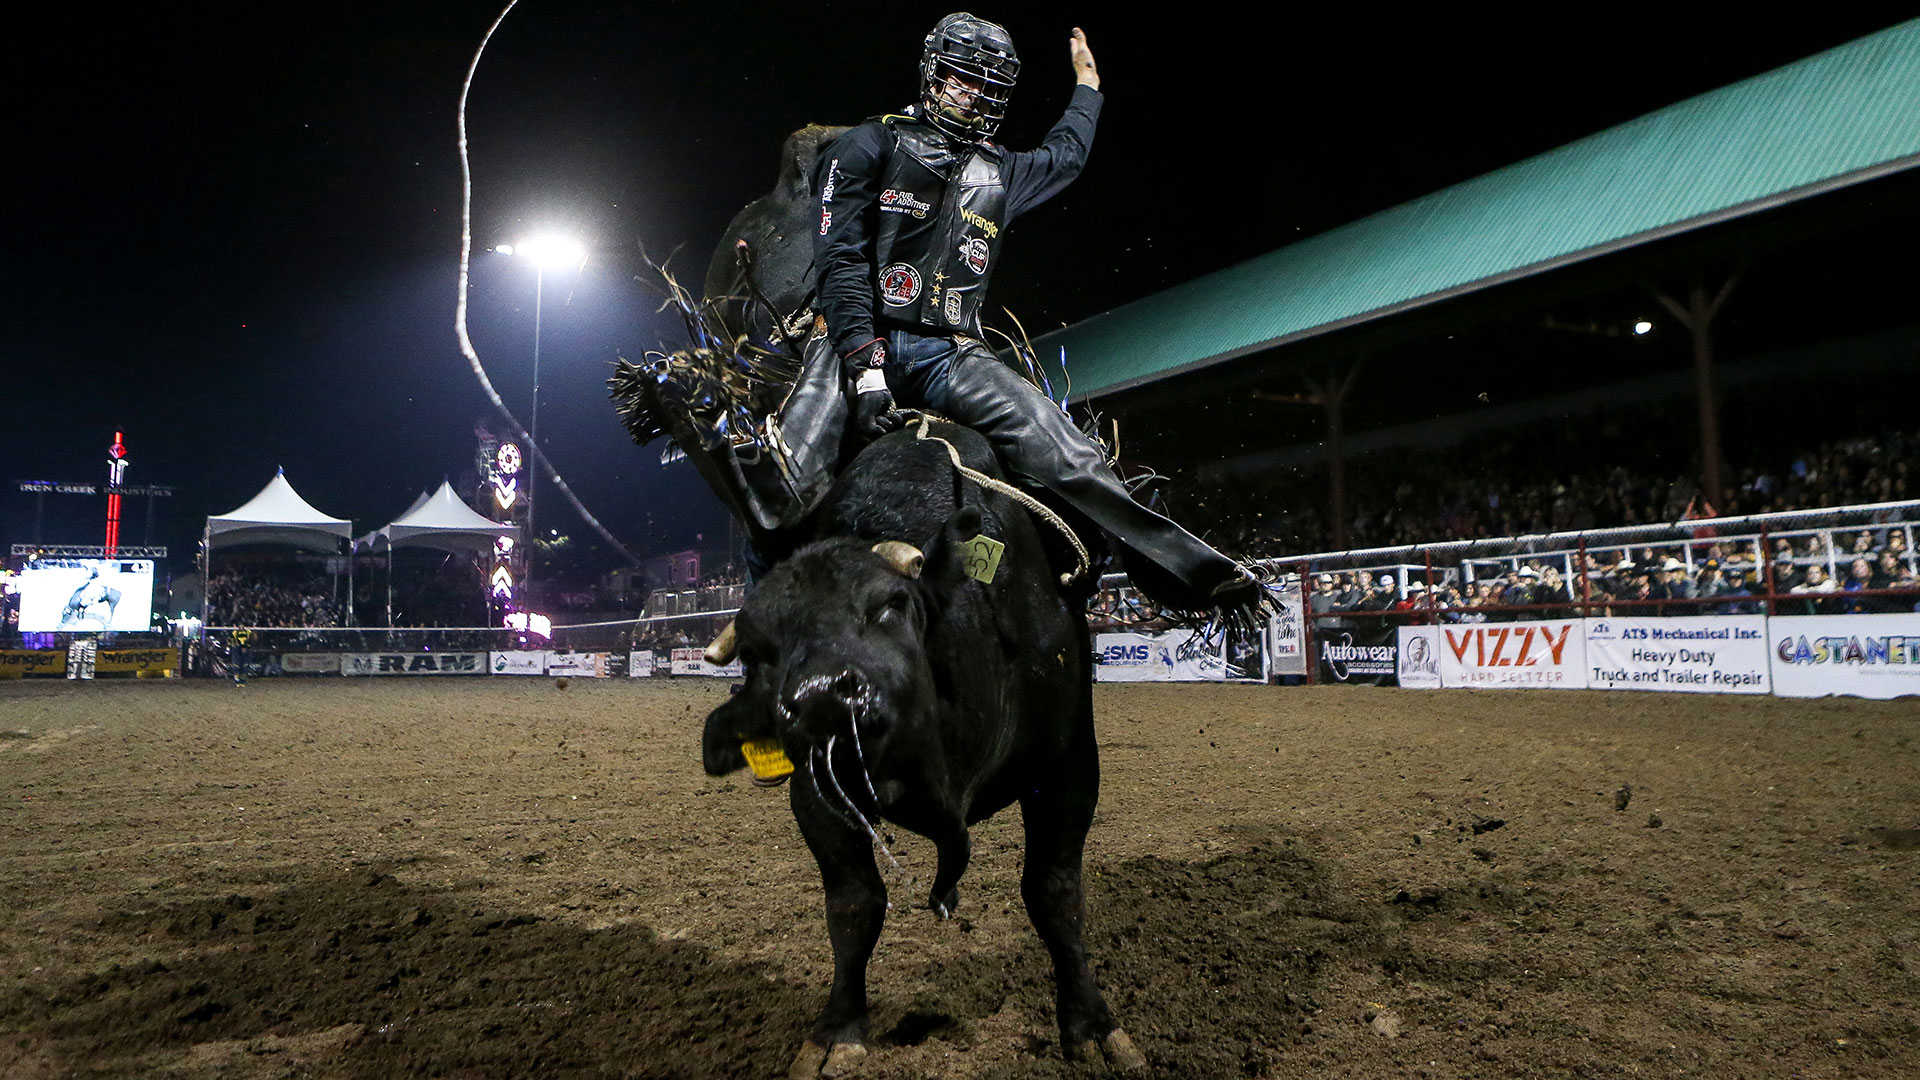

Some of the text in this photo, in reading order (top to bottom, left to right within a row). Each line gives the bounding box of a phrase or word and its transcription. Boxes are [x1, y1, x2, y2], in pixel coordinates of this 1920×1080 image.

[899, 191, 914, 200] FUEL
[897, 198, 931, 210] ADDITIVES
[56, 484, 97, 494] CREEK
[1622, 628, 1648, 639] ATS
[1652, 627, 1729, 639] Mechanical
[1735, 627, 1762, 639] Inc.
[1110, 645, 1149, 660] SMS
[1321, 636, 1396, 661] Autowear
[1445, 625, 1572, 666] VIZZY
[1777, 634, 1920, 665] CASTANET
[0, 653, 56, 670] rangler
[379, 655, 475, 671] RAM
[1632, 648, 1715, 666] Heavy Duty
[1460, 672, 1495, 682] HARD
[1502, 671, 1564, 682] SELTZER
[1593, 668, 1763, 688] Truck and Trailer Repair
